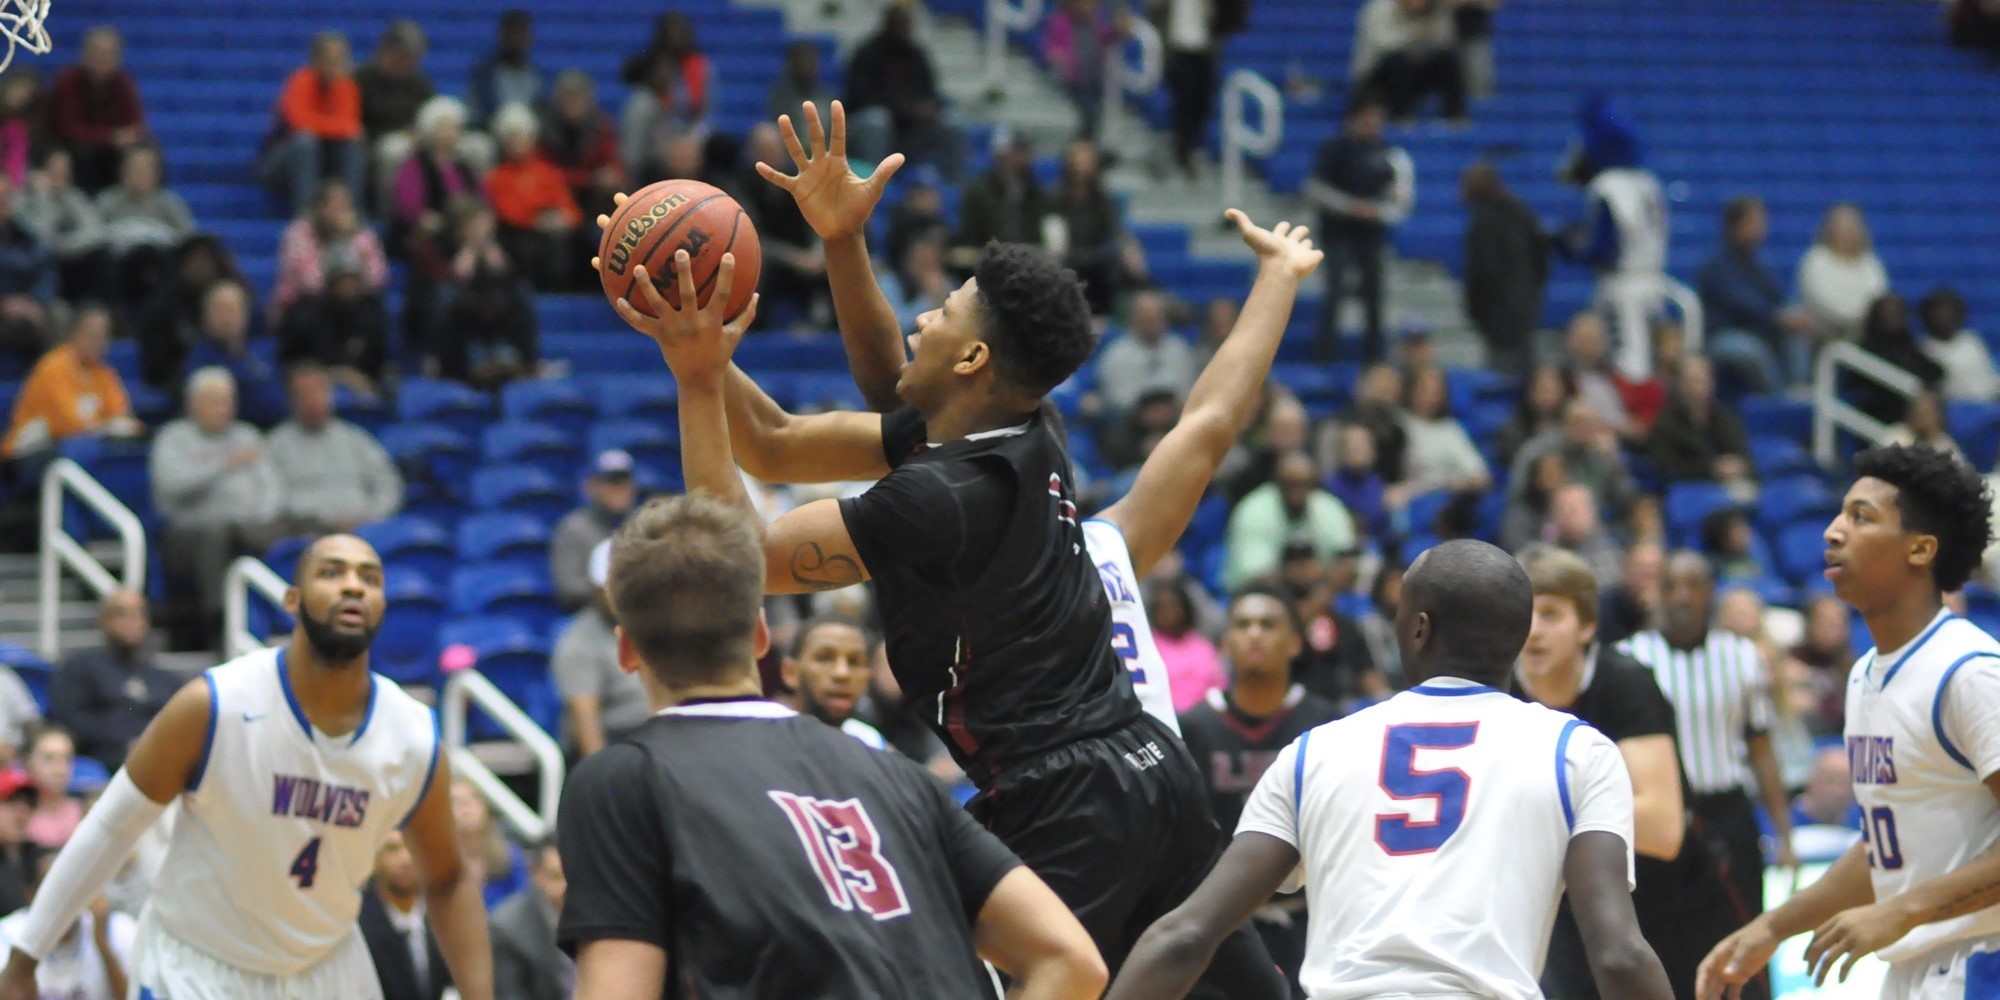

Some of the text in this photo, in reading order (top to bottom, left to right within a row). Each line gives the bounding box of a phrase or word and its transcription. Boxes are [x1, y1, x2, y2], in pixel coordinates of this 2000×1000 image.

[607, 192, 690, 276] Wilson
[272, 772, 371, 828] WOLVES
[1374, 720, 1480, 856] 5
[288, 837, 322, 888] 4
[766, 790, 911, 921] 13
